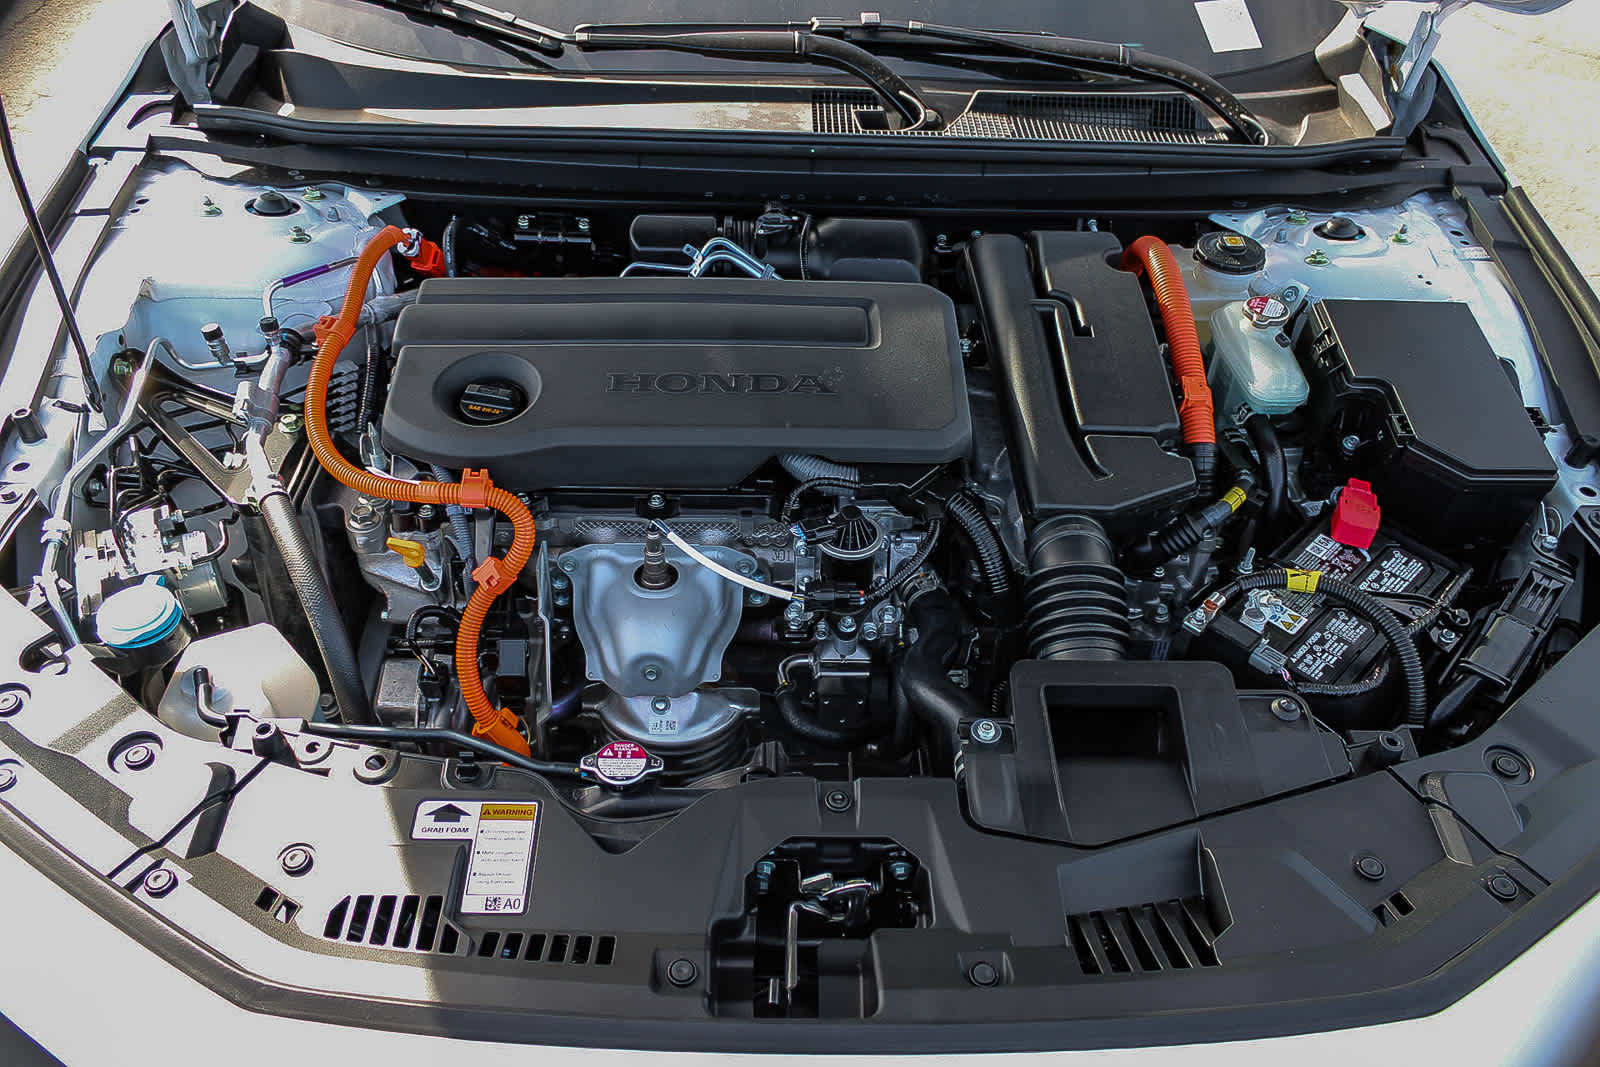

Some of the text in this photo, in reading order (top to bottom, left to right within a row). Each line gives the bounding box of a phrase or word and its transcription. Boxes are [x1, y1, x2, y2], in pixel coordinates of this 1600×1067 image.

[605, 372, 838, 394] HONDA
[492, 808, 533, 816] WARNING
[503, 898, 521, 910] A0
